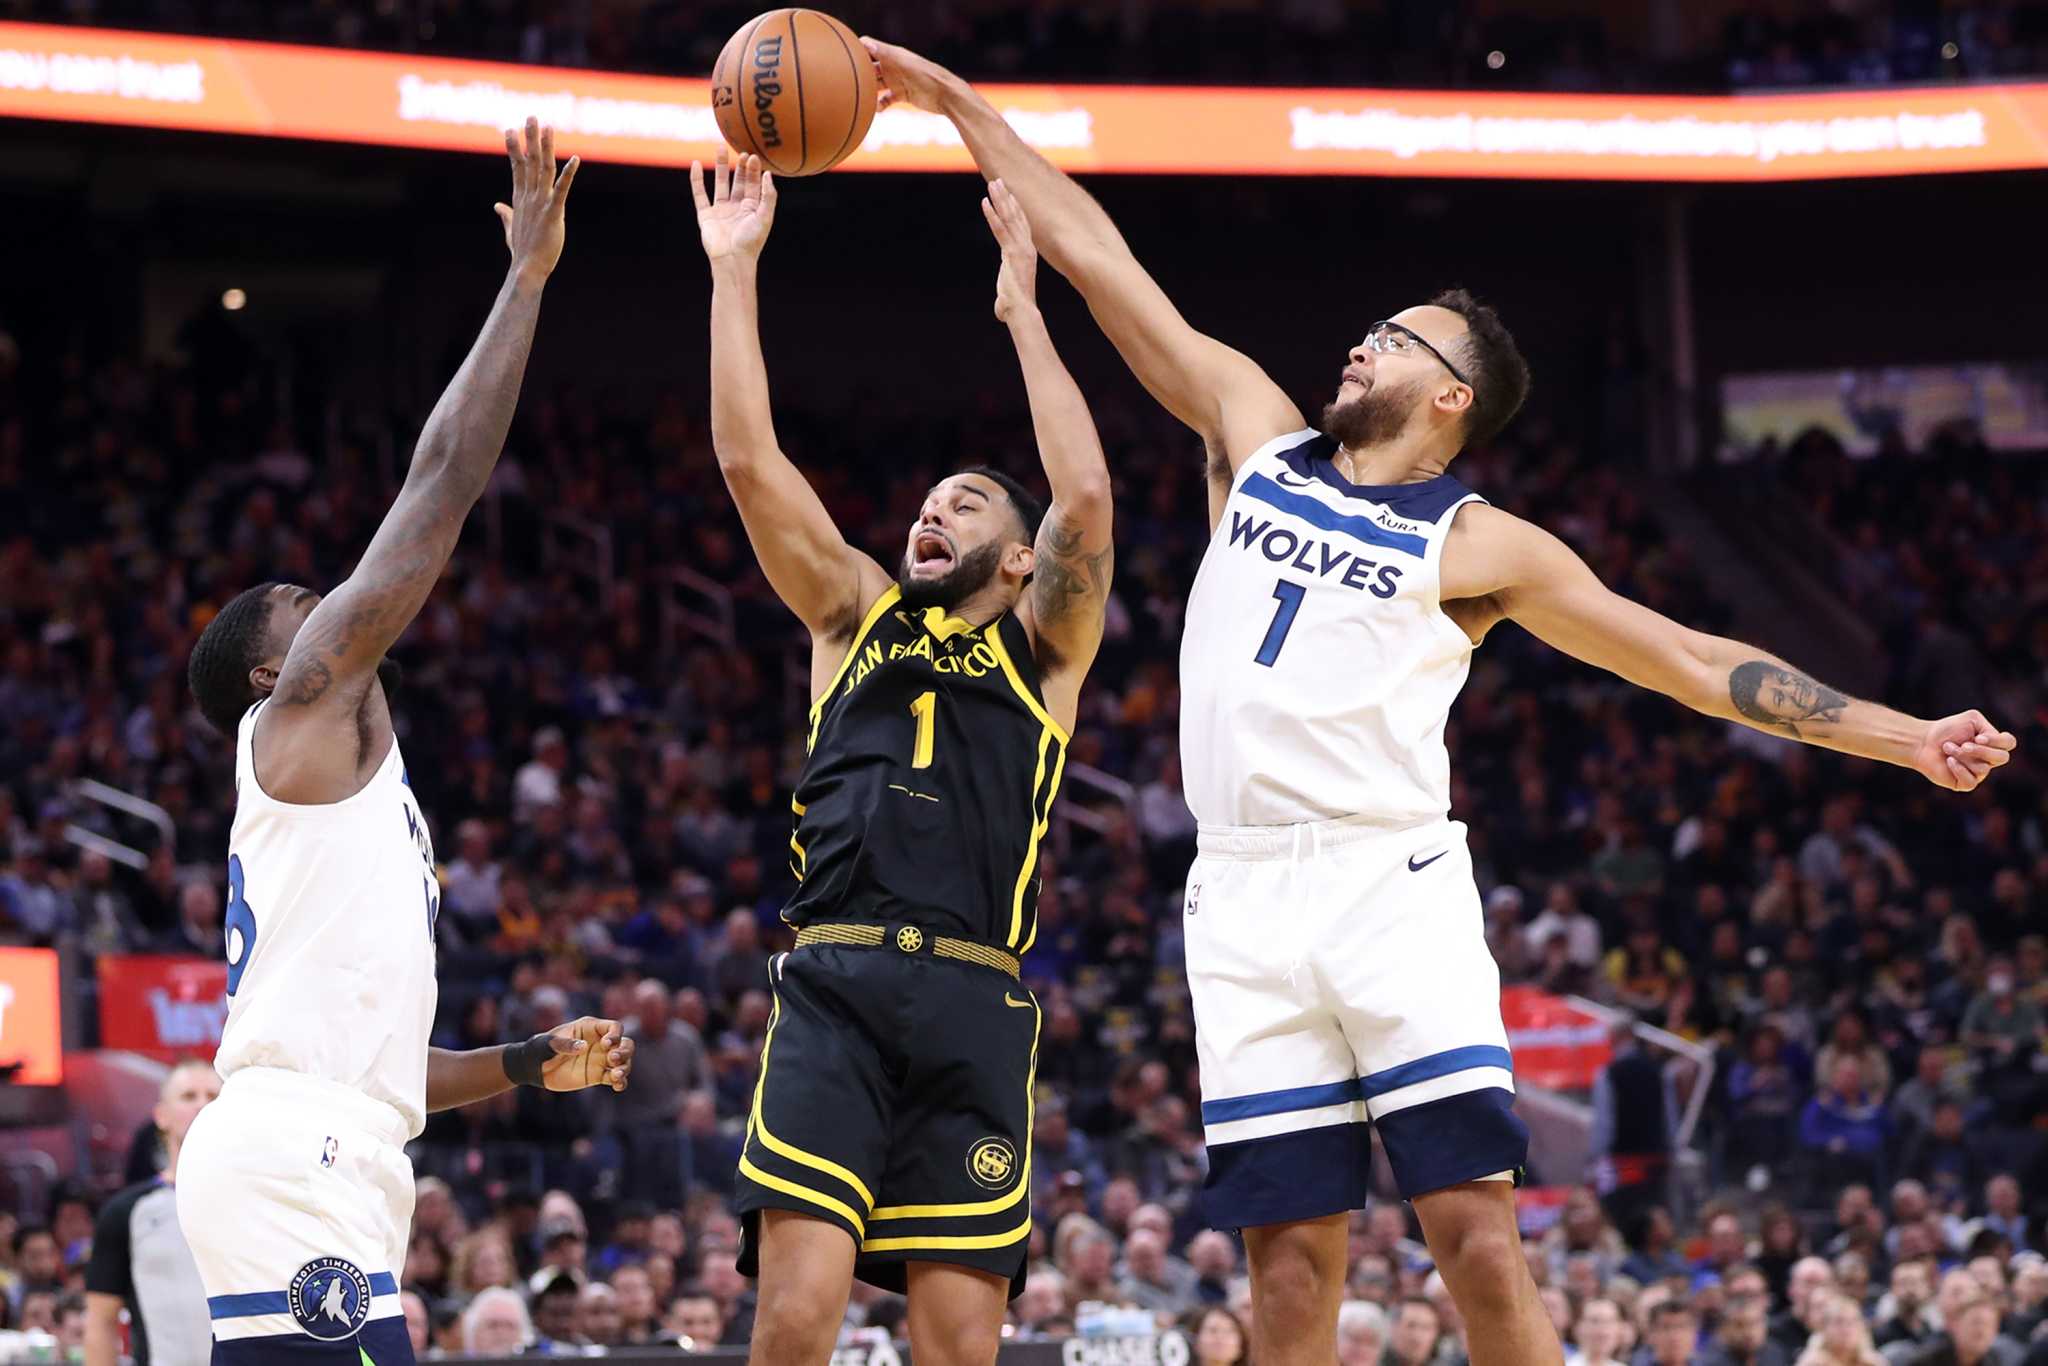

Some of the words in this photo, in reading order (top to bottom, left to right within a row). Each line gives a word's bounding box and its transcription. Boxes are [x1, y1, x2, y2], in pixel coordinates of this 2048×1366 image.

[752, 36, 783, 148] Wilson
[1229, 511, 1404, 600] WOLVES
[1253, 578, 1308, 668] 1
[843, 639, 884, 697] SAN
[910, 690, 937, 770] 1
[291, 1262, 319, 1318] MINNESOTA
[322, 1258, 369, 1320] TIMBERWOLVES
